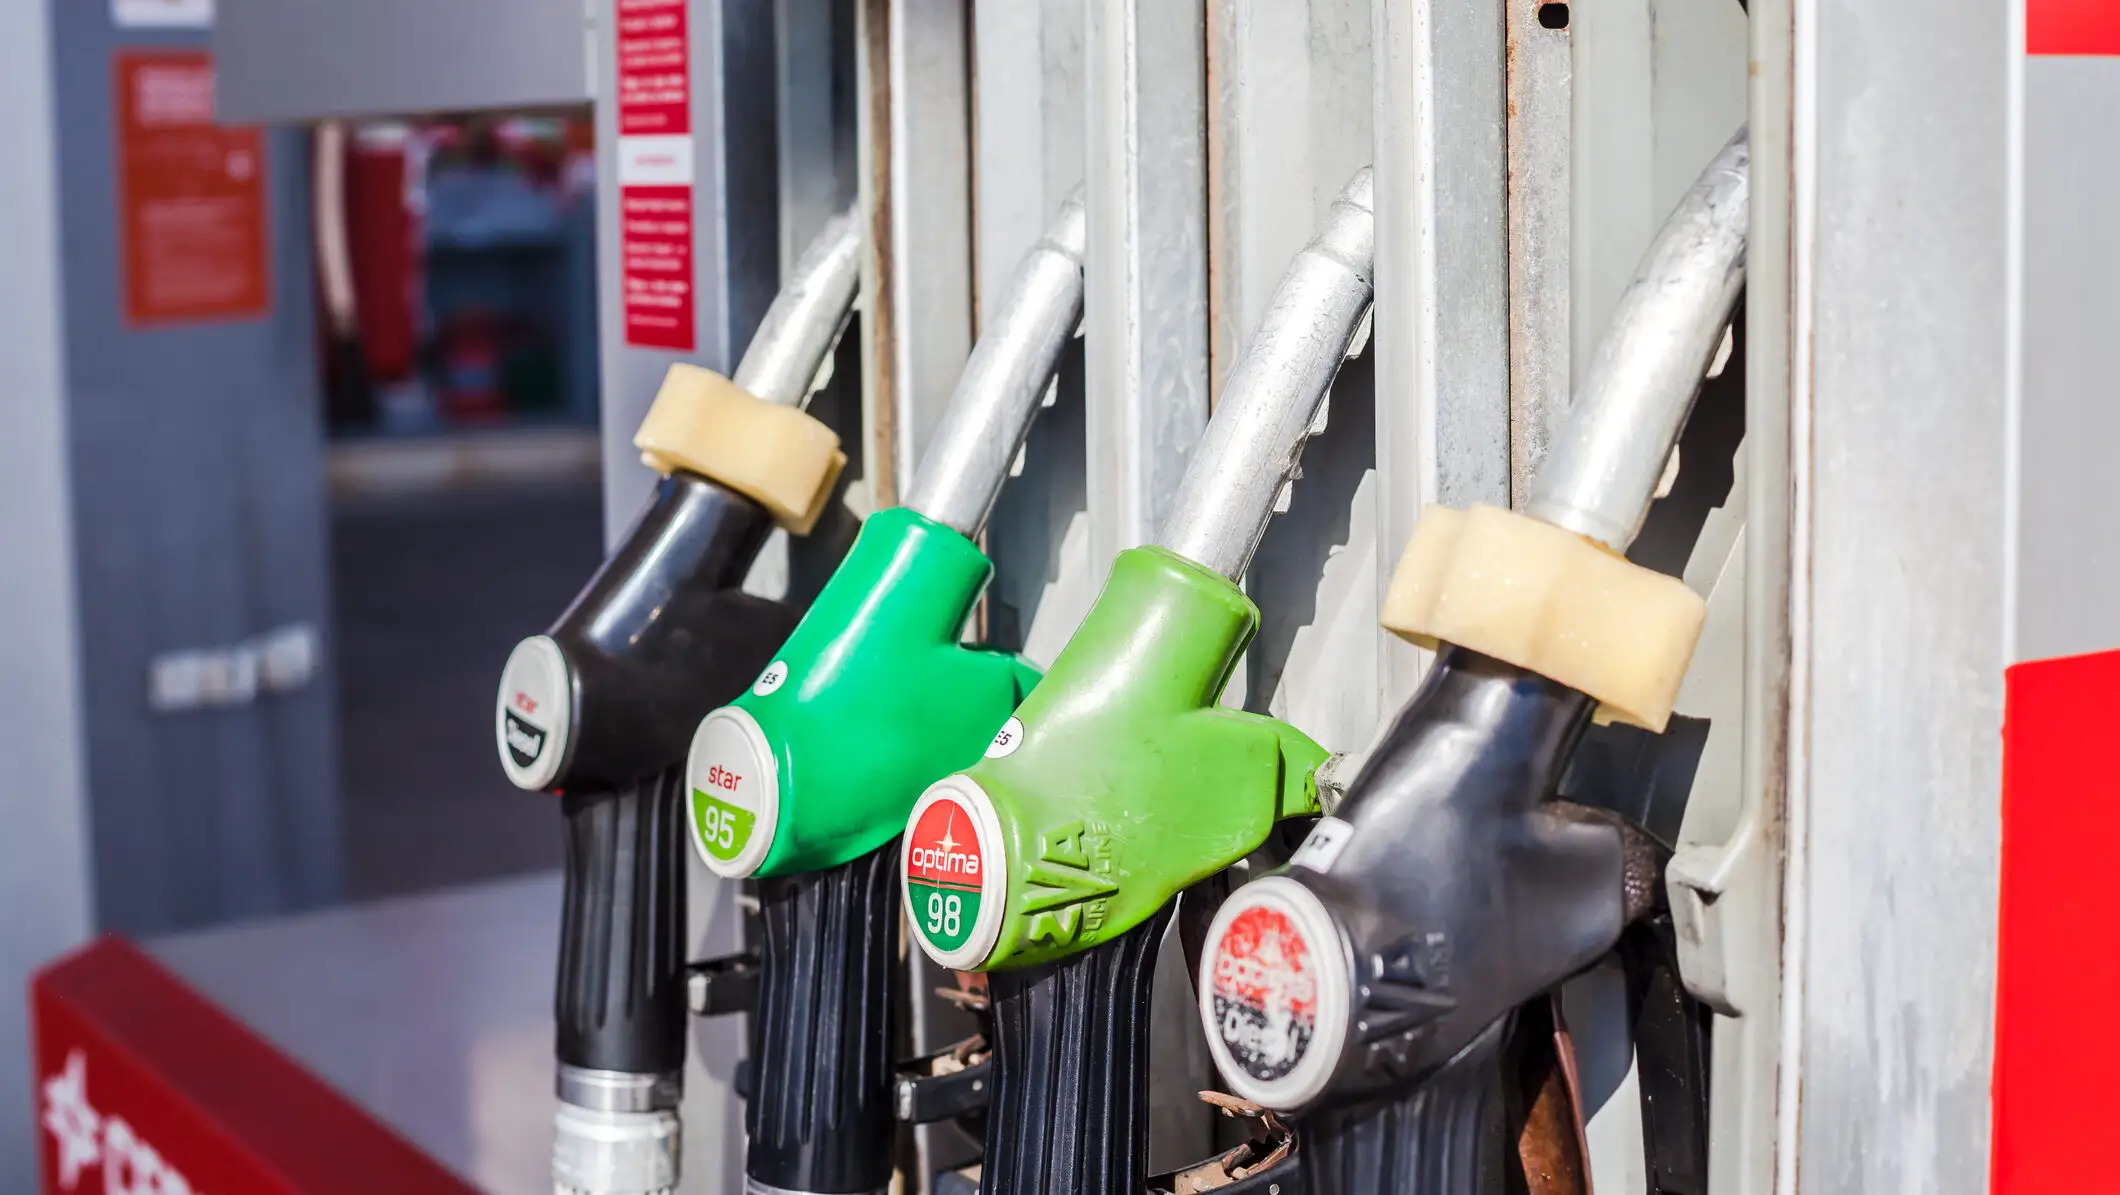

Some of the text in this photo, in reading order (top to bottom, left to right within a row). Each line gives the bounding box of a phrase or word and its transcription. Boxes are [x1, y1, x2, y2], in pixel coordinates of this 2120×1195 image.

[762, 672, 779, 685] E5
[708, 764, 742, 792] star
[704, 805, 736, 849] 95
[912, 847, 979, 876] optima
[927, 892, 962, 938] 98
